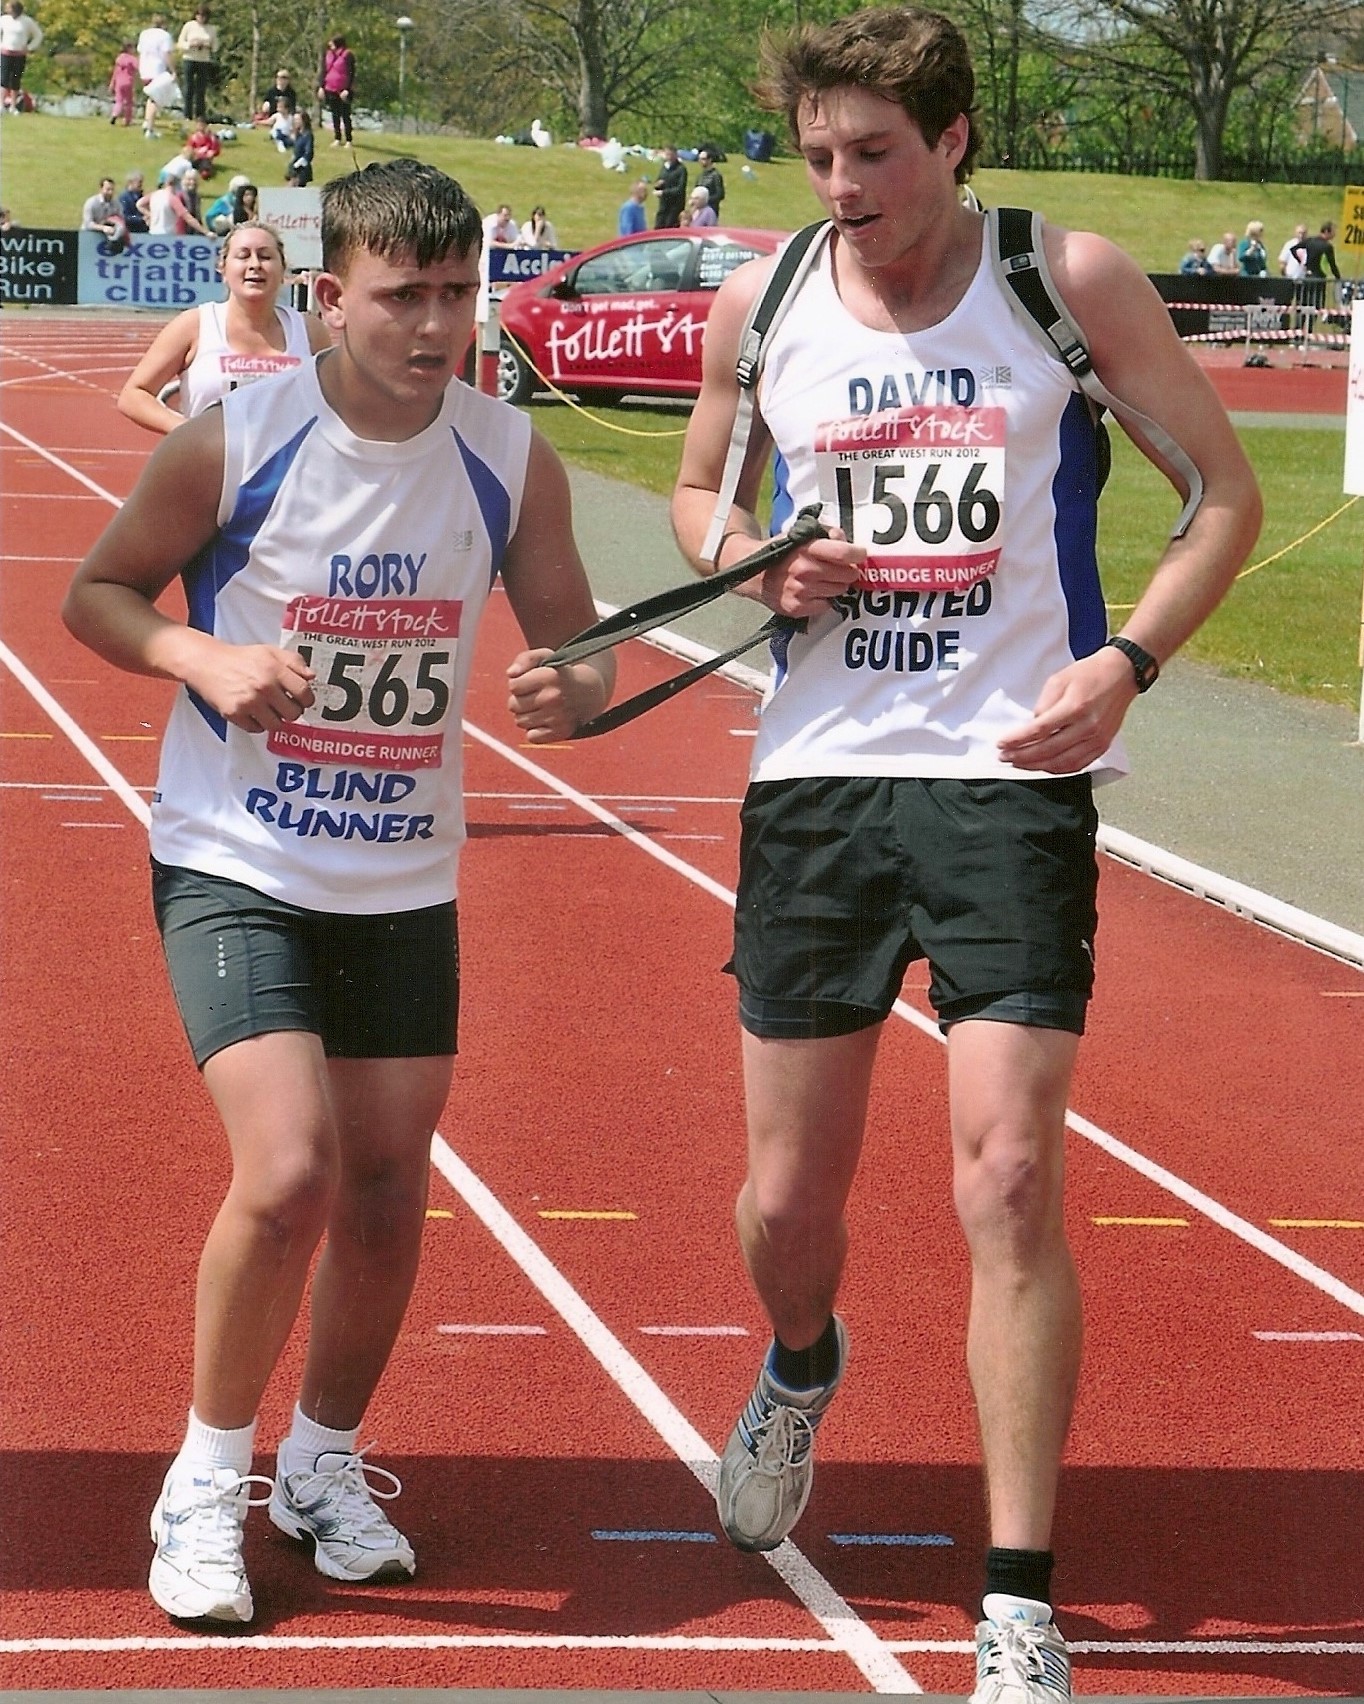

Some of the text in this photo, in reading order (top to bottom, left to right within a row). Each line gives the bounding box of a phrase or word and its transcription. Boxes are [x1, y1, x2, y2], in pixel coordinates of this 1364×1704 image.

[0, 234, 64, 254] wim
[1345, 224, 1364, 244] 2h
[502, 253, 571, 275] Accl
[105, 283, 197, 303] club
[849, 368, 976, 417] DAVID
[838, 448, 980, 461] THE GREAT WEST RUN 2012
[836, 462, 1000, 545] 1566
[329, 553, 427, 599] RORY
[859, 560, 996, 583] NBRIDGE RUNNER
[847, 578, 992, 621] IGHTED
[303, 633, 436, 649] THE GREAT WEST RUN 2012
[845, 628, 959, 672] GUIDE
[274, 731, 438, 761] IRONBRIDGE RUNNER
[276, 762, 417, 804] BLIND
[246, 787, 435, 843] RUNNER
